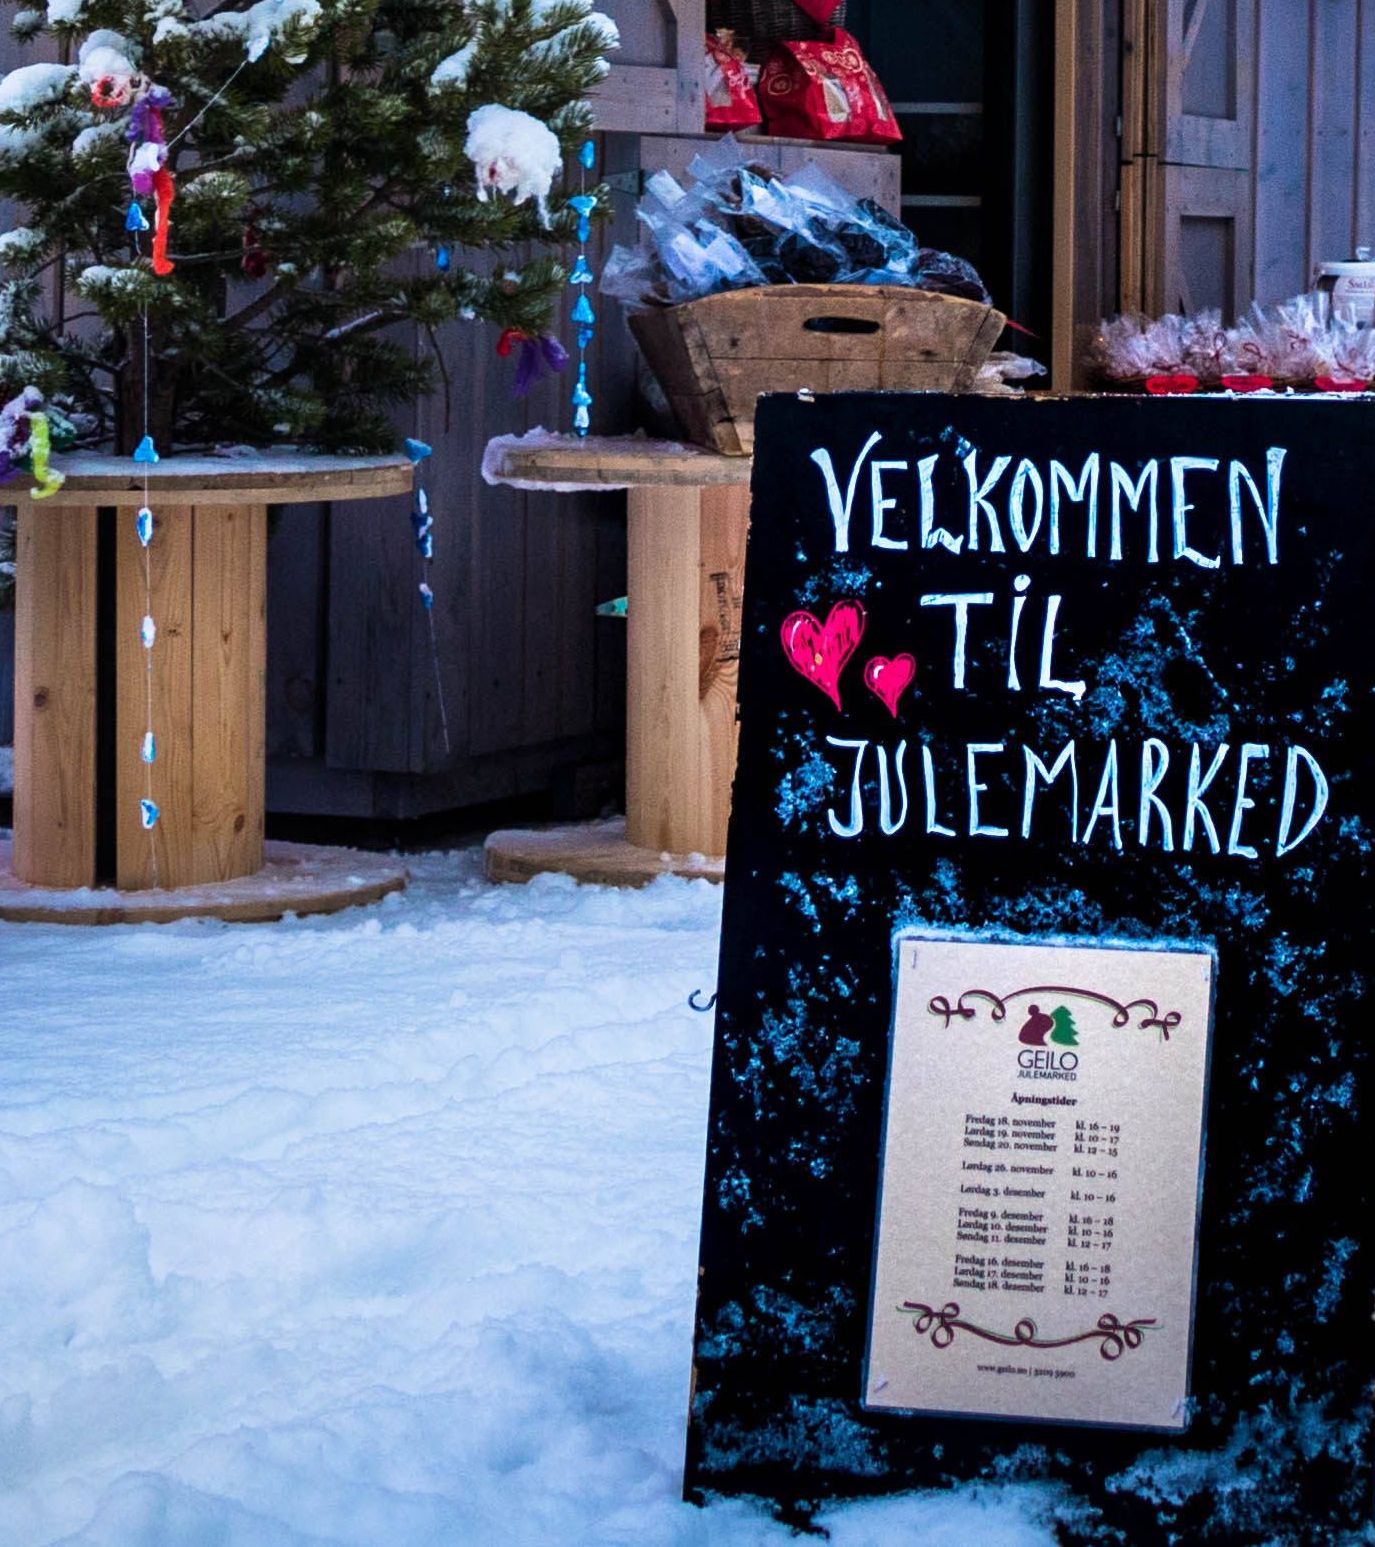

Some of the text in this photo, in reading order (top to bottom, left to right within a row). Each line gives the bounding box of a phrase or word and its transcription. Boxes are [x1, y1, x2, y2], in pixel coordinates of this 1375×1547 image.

[810, 432, 1288, 569] VELKOMMEN
[825, 736, 1330, 861] JULEMARKED
[1017, 1049, 1079, 1071] GEILO
[1017, 1070, 1077, 1081] JULEMARKED
[1010, 1091, 1078, 1106] Åpningstider
[966, 1114, 995, 1126] Fredag
[998, 1116, 1009, 1125] 18.
[1012, 1118, 1056, 1128] november
[1076, 1121, 1086, 1130] kl.
[1089, 1121, 1099, 1130] 16
[1110, 1124, 1120, 1133] 19
[965, 1127, 994, 1138] Lørdag
[998, 1129, 1009, 1138] 19.
[1012, 1130, 1055, 1140] november
[1075, 1132, 1085, 1142] kl.
[1110, 1136, 1119, 1144] 17
[963, 1138, 995, 1150] Søndag
[998, 1141, 1010, 1149] 20.
[1014, 1141, 1057, 1152] november
[1074, 1144, 1084, 1153] kl.
[1088, 1146, 1097, 1154] 12
[1109, 1148, 1117, 1157] 15
[963, 1161, 992, 1173] Lørdag
[995, 1164, 1008, 1172] 26.
[1010, 1164, 1053, 1175] november
[1073, 1167, 1083, 1177] kl.
[1086, 1169, 1096, 1178] 10
[1107, 1170, 1117, 1179] 16
[961, 1184, 990, 1196] Lørdag
[993, 1188, 1000, 1196] 3.
[1003, 1187, 1045, 1198] desember
[1071, 1191, 1081, 1200] kl.
[1106, 1194, 1115, 1202] 16
[959, 1208, 988, 1220] Fredag
[990, 1211, 998, 1219] 9.
[1001, 1210, 1043, 1221] desember
[1069, 1214, 1079, 1224] kl.
[1083, 1216, 1092, 1225] 16
[1103, 1217, 1113, 1226] 18
[958, 1220, 988, 1231] Lørdag
[991, 1222, 1003, 1231] 10.
[1005, 1222, 1047, 1233] desember
[1068, 1226, 1078, 1235] kl.
[1103, 1229, 1113, 1238] 16
[957, 1231, 988, 1243] Søndag
[1004, 1233, 1046, 1245] desember
[1068, 1238, 1077, 1247] kl.
[1102, 1242, 1111, 1250] 17
[955, 1254, 985, 1266] Fredag
[987, 1257, 999, 1265] 16.
[1002, 1257, 1044, 1269] desember
[1066, 1261, 1076, 1271] kl.
[1079, 1263, 1089, 1272] 16
[1100, 1264, 1110, 1273] 18
[954, 1266, 984, 1278] Lørdag
[987, 1270, 998, 1278] 17.
[1001, 1269, 1043, 1281] desember
[1065, 1273, 1075, 1283] kl.
[1079, 1276, 1088, 1284] 10
[1100, 1276, 1110, 1285] 16
[953, 1278, 985, 1290] Søndag
[988, 1281, 999, 1289] 18.
[1002, 1281, 1044, 1293] desember
[1064, 1285, 1074, 1295] kl.
[1099, 1289, 1108, 1298] 17
